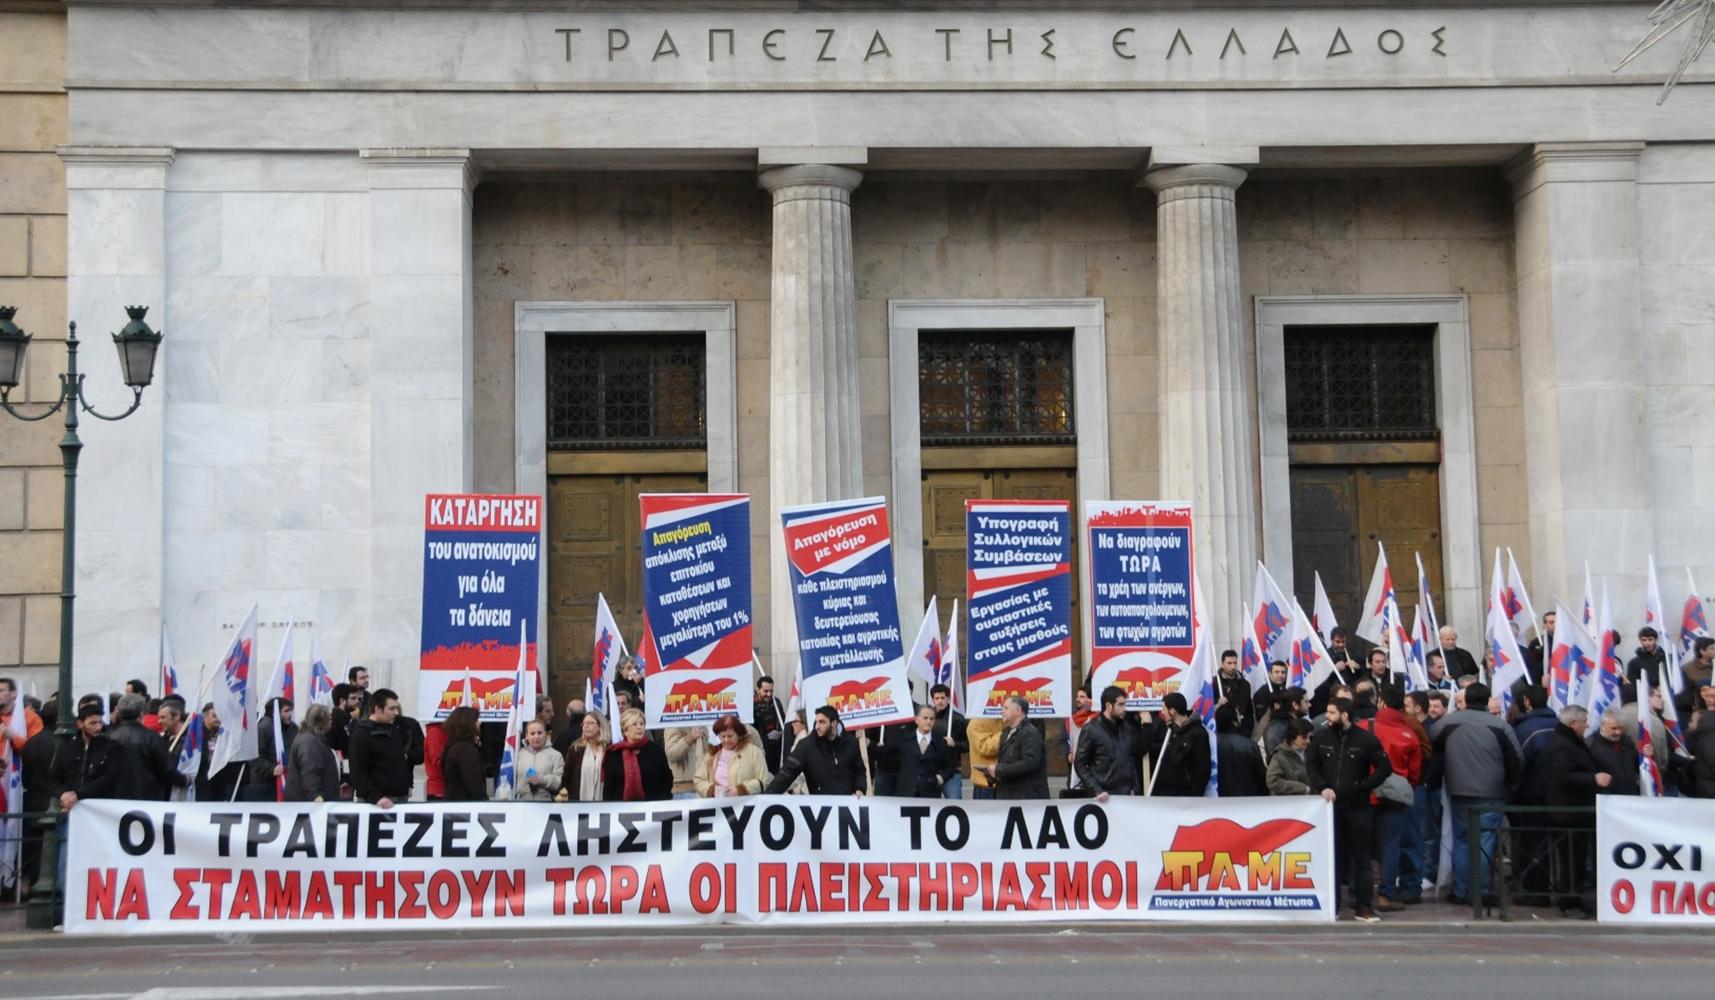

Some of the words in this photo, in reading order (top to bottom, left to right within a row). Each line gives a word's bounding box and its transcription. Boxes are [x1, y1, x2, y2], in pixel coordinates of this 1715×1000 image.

[555, 28, 892, 62] ΤΡΑΠΕΖΑ
[935, 28, 1056, 62] ΤΗΣ
[1112, 26, 1447, 61] ΕΛΛΑΔΟΣ
[430, 498, 537, 527] ΚΑΤΑΡΓΗΣΗ
[977, 516, 1059, 533] Υπογραφή
[652, 521, 712, 546] Απαγόρευση
[794, 513, 878, 551] Απαγόρευση
[974, 532, 1063, 548] Συλλογικών
[1098, 533, 1114, 549] Να
[1117, 532, 1181, 552] διαγραφούν
[428, 542, 452, 560] του
[453, 536, 536, 566] ανατοκισμού
[645, 548, 695, 569] απόκλισης
[695, 533, 728, 559] μεταξύ
[813, 546, 831, 562] με
[834, 533, 866, 553] νόμο
[973, 549, 1063, 565] Συμβάσεων
[670, 560, 715, 582] επιτοκίου
[1119, 555, 1162, 573] ΤΩΡΑ
[458, 575, 478, 599] για
[481, 569, 505, 593] όλα
[659, 580, 716, 606] καταθέσεων
[716, 576, 732, 590] και
[797, 579, 818, 595] κάθε
[820, 570, 887, 592] πλειστηριασμού
[1097, 583, 1108, 595] τα
[1109, 578, 1130, 599] χρέη
[1131, 583, 1147, 595] των
[1148, 578, 1186, 599] ανέργων,
[449, 608, 465, 626] τα
[468, 602, 511, 627] δάνεια
[672, 597, 728, 627] χορηγήσεων
[822, 595, 852, 611] κύριας
[853, 595, 867, 607] και
[970, 593, 1031, 619] Εργασίας
[1032, 586, 1049, 602] με
[975, 600, 1053, 632] ουσιαστικές
[1096, 604, 1109, 617] των
[659, 622, 715, 651] μεγαλύτερη
[715, 616, 732, 632] του
[733, 610, 748, 626] 1%
[814, 611, 879, 631] δευτερεύουσας
[989, 616, 1047, 642] αυξήσεις
[1099, 626, 1115, 639] των
[1116, 622, 1150, 643] φτωχών
[1151, 621, 1187, 642] αγροτών
[800, 633, 841, 651] κατοικίας
[842, 633, 856, 645] και
[857, 624, 899, 646] αγροτικής
[974, 641, 1015, 661] στους
[1016, 623, 1069, 649] μισθούς
[820, 648, 884, 669] εκμετάλλευσης
[665, 692, 737, 713] ΠΑΜΕ
[118, 810, 176, 856] ΟΙ
[209, 812, 507, 859] ΤΡΑΠΕΖΕΣ
[536, 805, 870, 857] ΛΗΣΤΕΥΟΥΝ
[900, 805, 970, 851] ΤΟ
[1000, 803, 1109, 850] ΛΑΟ
[1611, 841, 1703, 871] ΟΧΙ
[1160, 850, 1315, 891] ΠΑΜΕ
[85, 867, 150, 920] ΝΑ
[169, 867, 526, 920] ΣΤΑΜΑΤΗΣΟΥΝ
[545, 863, 671, 915] ΤΩΡΑ
[689, 862, 737, 914] ΟΙ
[758, 860, 1138, 913] ΠΛΕΙΣΤΗΡΙΑΣΜΟΙ
[1155, 896, 1215, 908] Πανεργατικό
[1217, 896, 1271, 909] Αγωνιστικό
[1273, 896, 1313, 907] Μέτωπο
[1610, 878, 1635, 914] Ο
